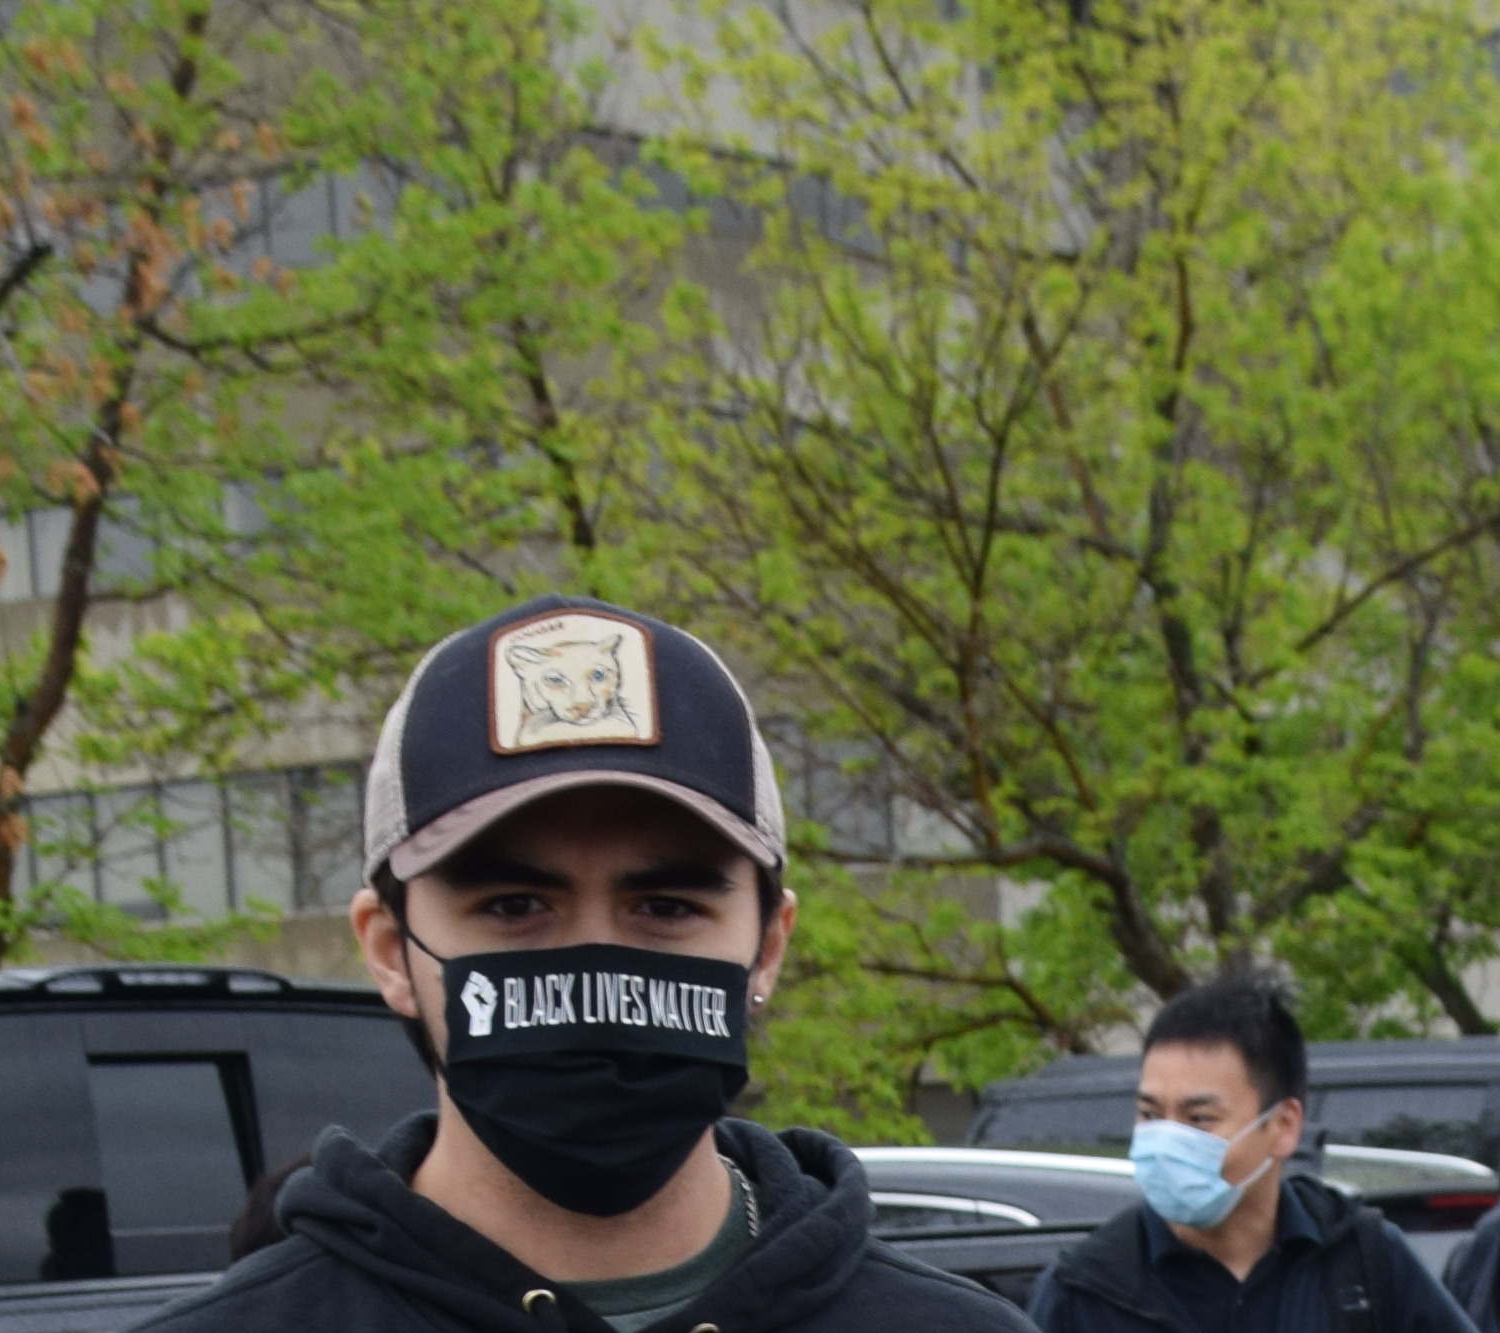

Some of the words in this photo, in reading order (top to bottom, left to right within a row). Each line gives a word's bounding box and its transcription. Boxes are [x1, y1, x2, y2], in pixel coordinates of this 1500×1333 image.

[504, 972, 577, 1030] BLACK
[582, 971, 649, 1028] LIVES
[649, 977, 732, 1038] MATTER
